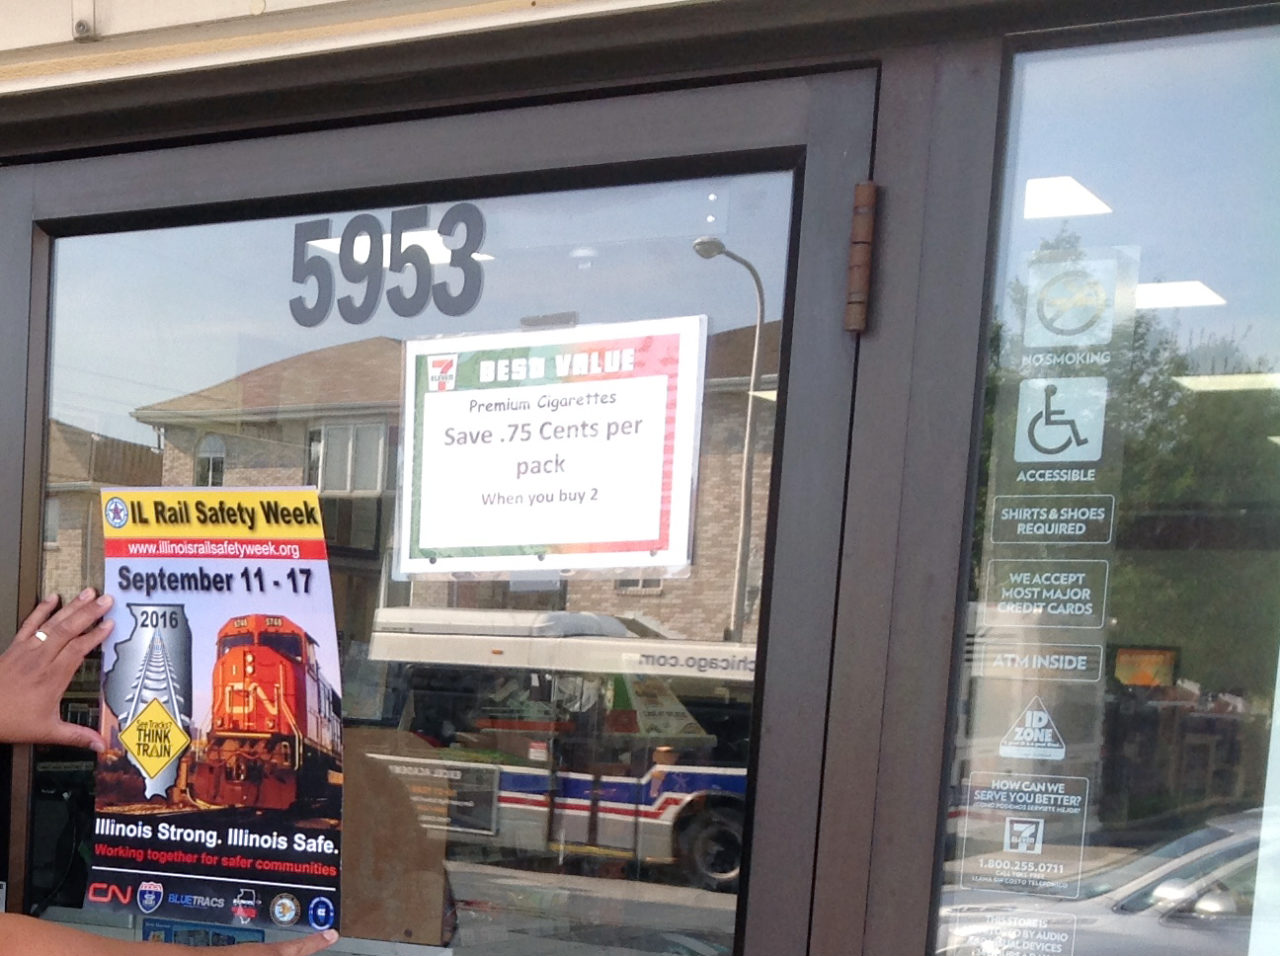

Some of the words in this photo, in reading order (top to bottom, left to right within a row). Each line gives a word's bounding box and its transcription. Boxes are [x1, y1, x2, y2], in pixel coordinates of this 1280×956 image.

[288, 202, 487, 328] 5953
[555, 348, 635, 378] VALUE
[1022, 354, 1043, 366] NO
[1044, 351, 1111, 365] SMOKING
[470, 398, 531, 413] Premium
[537, 391, 616, 412] Cigarettes
[444, 427, 493, 446] Save
[500, 423, 532, 443] .75
[539, 421, 599, 441] Cents
[606, 419, 643, 440] per
[516, 454, 566, 479] pack
[1017, 469, 1096, 482] ACCESSIBLE
[482, 492, 523, 505] When
[528, 492, 554, 506] you
[559, 489, 586, 504] buy
[590, 488, 599, 501] 2
[131, 501, 148, 525] IL
[154, 500, 190, 525] Rail
[195, 500, 256, 530] Safety
[260, 500, 318, 525] Week
[1001, 508, 1047, 520] SHIRTS
[1048, 508, 1058, 520] &
[1060, 508, 1105, 520] SHOES
[1017, 523, 1086, 535] REQUIRED
[128, 540, 300, 558] www.illinoisrailsafetyweek.org
[118, 565, 234, 597] September
[241, 567, 265, 593] 11
[287, 568, 312, 594] 17
[1010, 573, 1030, 584] WE
[1031, 573, 1086, 585] ACCEPT
[1001, 587, 1041, 599] MOST
[1042, 588, 1091, 600] MAJOR
[998, 602, 1046, 614] CREDIT
[1047, 602, 1093, 615] CARDS
[140, 611, 178, 628] 2016
[993, 655, 1029, 668] ATM
[1032, 656, 1087, 670] INSIDE
[1025, 711, 1048, 728] ID
[136, 728, 171, 743] THINK
[1014, 727, 1053, 742] ZONE
[136, 743, 171, 757] TRAIN
[991, 780, 1021, 790] HOW
[1022, 781, 1046, 792] CAN
[1047, 783, 1065, 793] WE
[974, 790, 1008, 801] SERVE
[1009, 792, 1034, 803] YOU
[1035, 794, 1082, 806] BETTER?
[95, 818, 152, 838] Illinois
[157, 822, 222, 847] Strong.
[227, 828, 288, 849] Illinois
[293, 833, 339, 854] Safe.
[94, 844, 144, 862] Working
[147, 848, 197, 864] together
[201, 854, 218, 865] for
[221, 857, 253, 869] safer
[255, 857, 337, 877] communities
[979, 859, 1065, 874] 1.800.255.0711
[88, 882, 133, 905] CN
[168, 892, 225, 909] BLUETRACS
[1036, 931, 1068, 942] AUDIO
